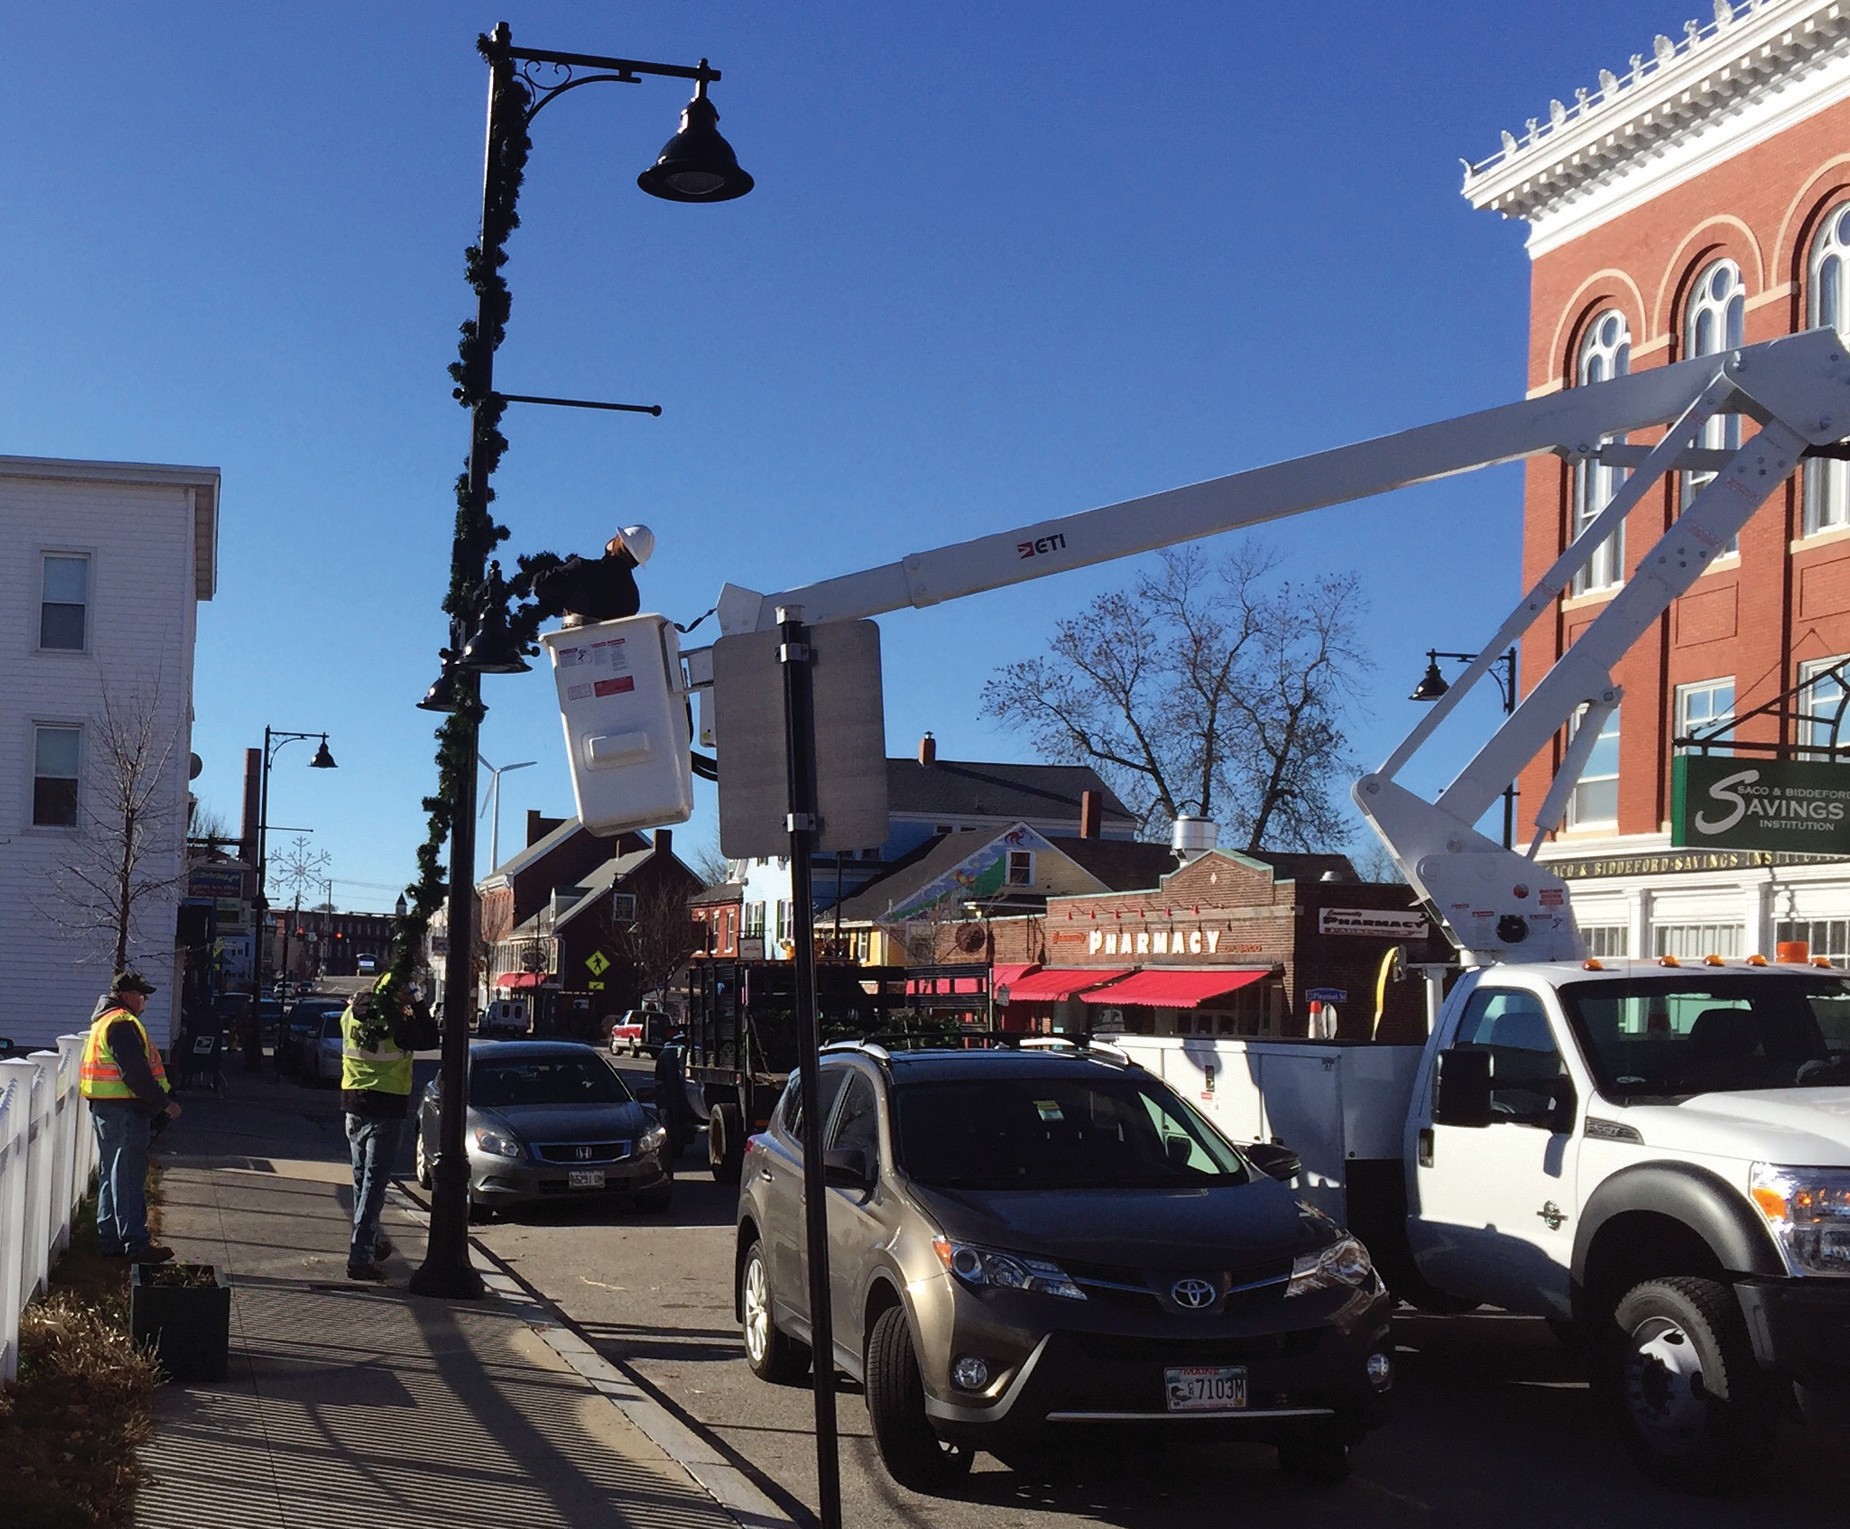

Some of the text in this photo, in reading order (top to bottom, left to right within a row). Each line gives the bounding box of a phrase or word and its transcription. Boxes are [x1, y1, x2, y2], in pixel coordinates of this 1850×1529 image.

[1034, 532, 1067, 555] ETI
[1737, 785, 1770, 796] SACO
[1773, 787, 1782, 796] &
[1759, 819, 1835, 831] INSTITUTION
[1594, 858, 1669, 876] BIDDEFORD
[1322, 916, 1431, 929] PHARMACY
[1088, 930, 1222, 955] PHARMACY
[1183, 1368, 1220, 1376] MAINE
[1195, 1377, 1245, 1400] 7103M
